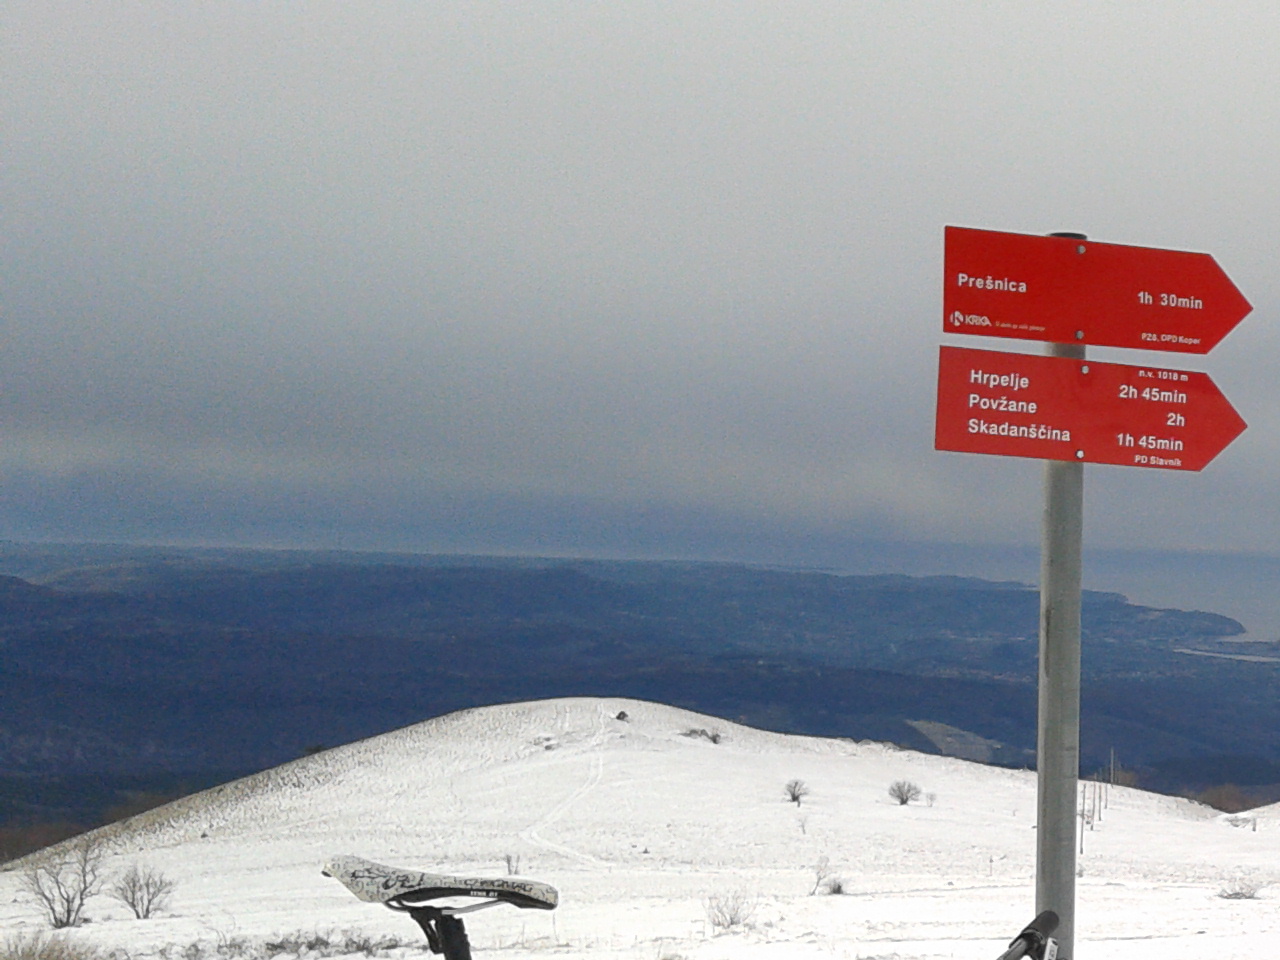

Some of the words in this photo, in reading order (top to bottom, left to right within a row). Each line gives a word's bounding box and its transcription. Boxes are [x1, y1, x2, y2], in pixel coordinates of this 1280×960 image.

[958, 272, 1027, 293] Prešnica
[1137, 291, 1153, 305] 1h
[1160, 293, 1203, 309] 30min
[970, 369, 1029, 391] Hrpelje
[1158, 371, 1178, 381] 1018
[1180, 374, 1189, 382] m
[969, 393, 1037, 413] Povžane
[1119, 384, 1138, 399] 2h
[1142, 387, 1187, 404] 45min
[1166, 412, 1185, 427] 2h
[968, 418, 1071, 441] Skadanščina
[1117, 433, 1134, 447] 1h
[1138, 435, 1184, 451] 45min
[1134, 454, 1148, 463] PD
[1150, 456, 1182, 467] Slavnik
